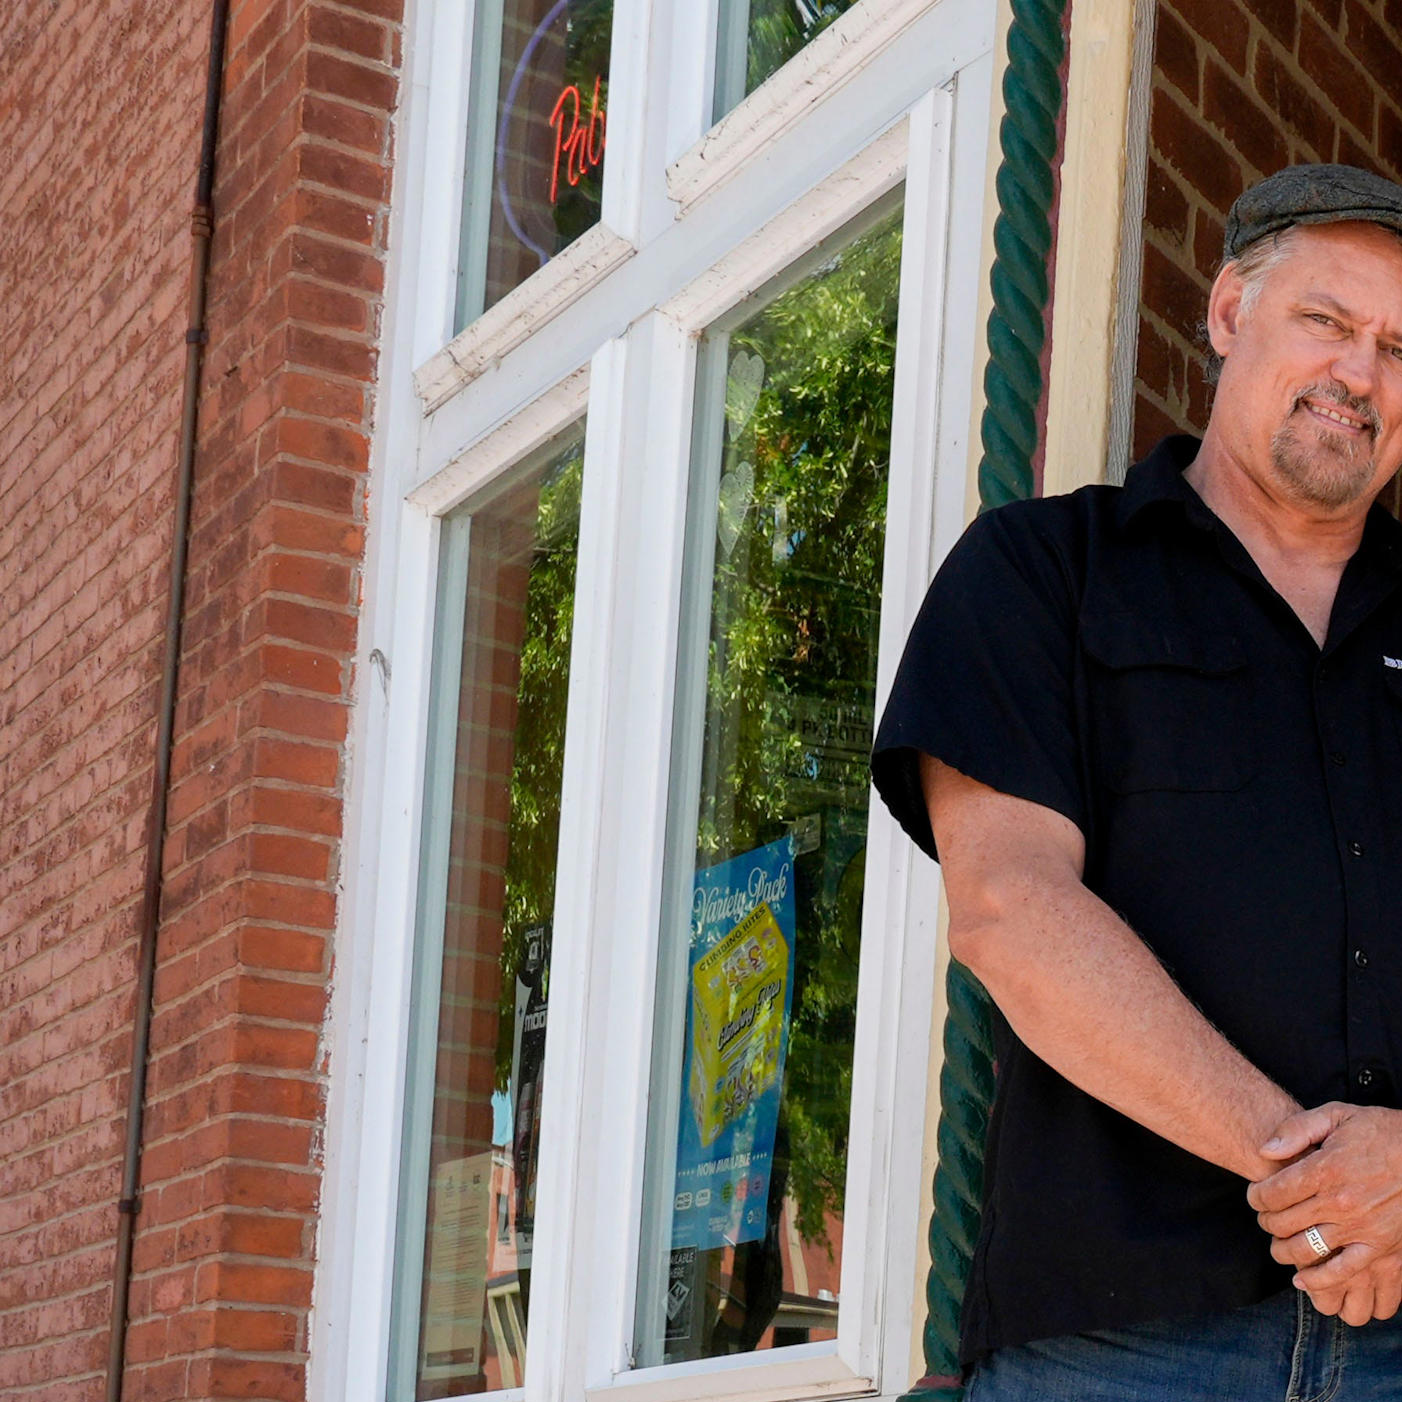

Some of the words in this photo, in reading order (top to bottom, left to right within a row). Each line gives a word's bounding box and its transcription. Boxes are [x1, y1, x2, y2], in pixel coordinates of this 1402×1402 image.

[548, 74, 607, 204] Pab
[693, 886, 747, 924] Variety
[747, 862, 789, 910] Pack
